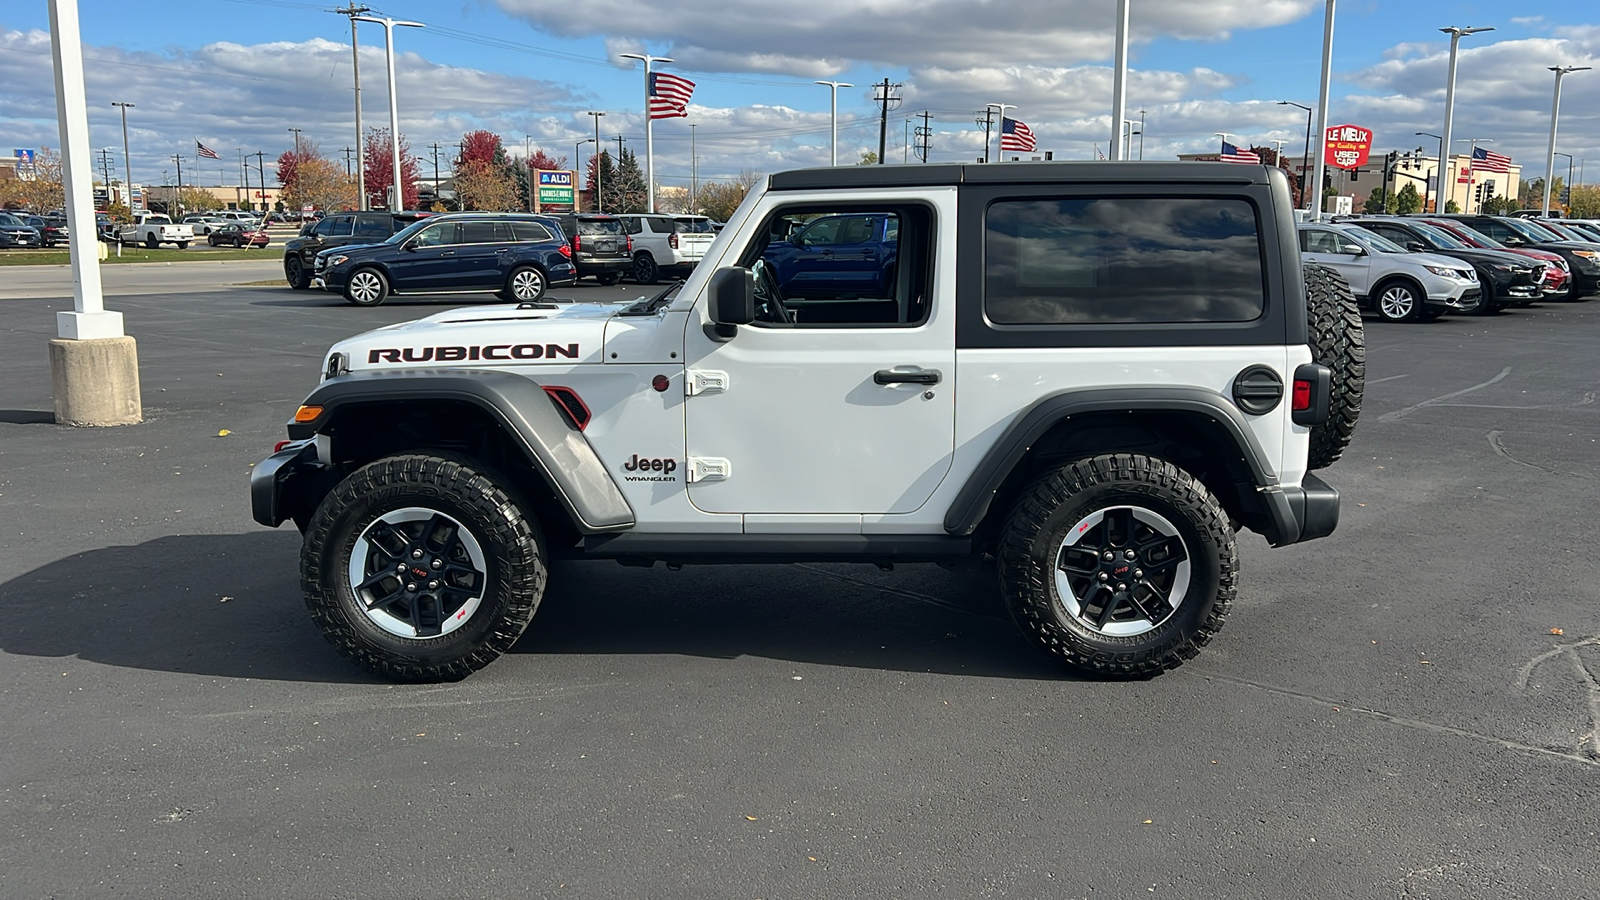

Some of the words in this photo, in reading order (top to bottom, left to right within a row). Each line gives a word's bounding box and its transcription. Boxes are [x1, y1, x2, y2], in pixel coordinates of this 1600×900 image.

[1327, 129, 1339, 141] LE
[1340, 127, 1368, 142] MIEUX
[1334, 150, 1360, 158] USED
[1336, 157, 1357, 166] CARS
[551, 174, 570, 184] ALDI
[367, 343, 580, 364] RUBICON
[624, 453, 677, 475] Jeep
[411, 566, 427, 578] Jeep
